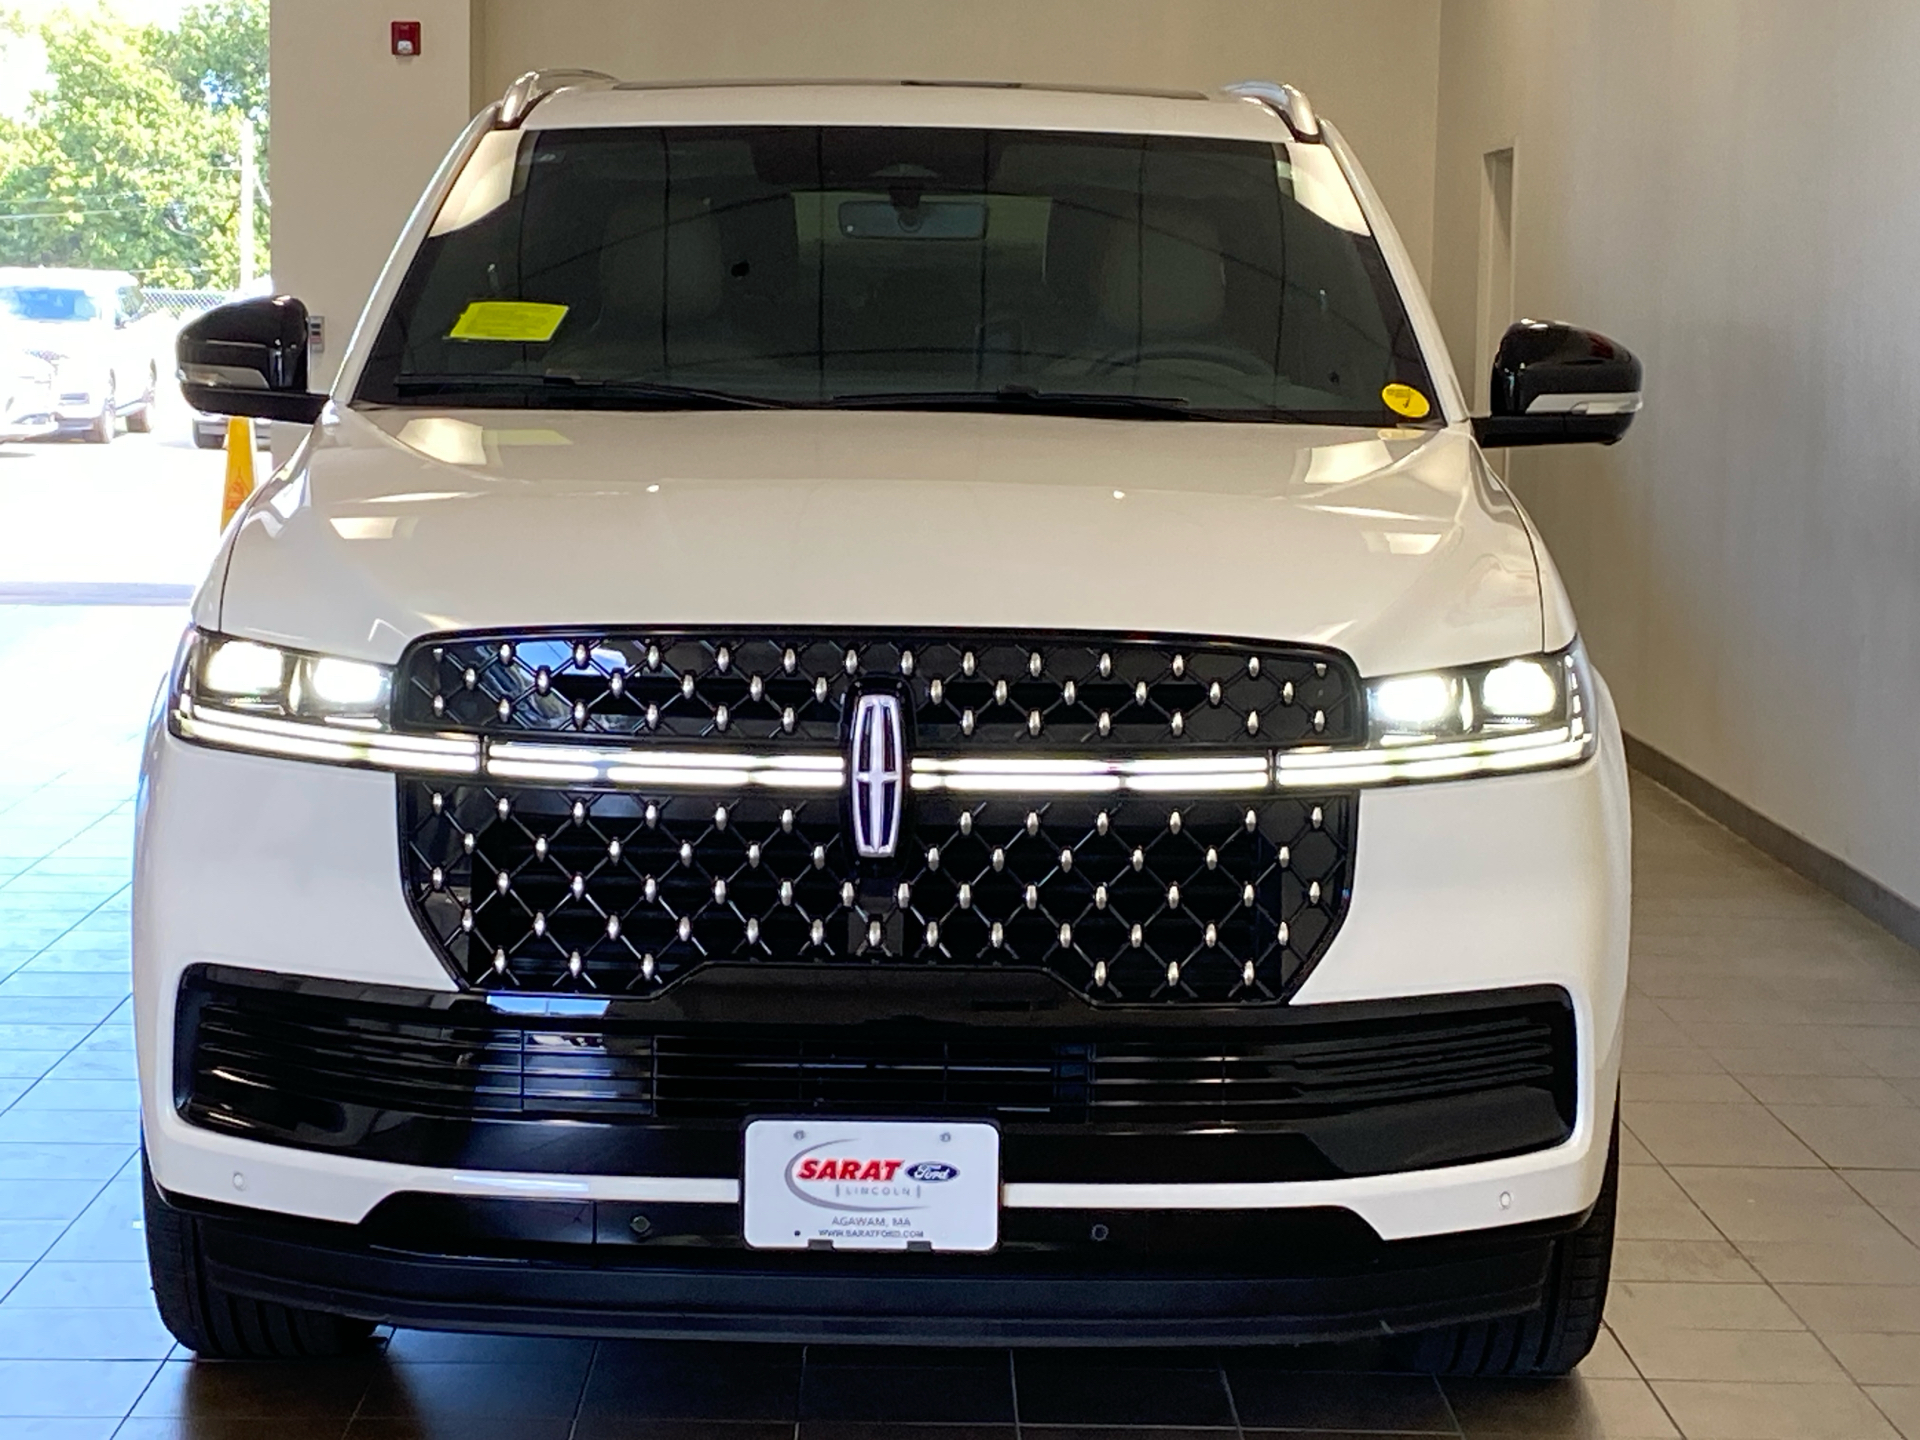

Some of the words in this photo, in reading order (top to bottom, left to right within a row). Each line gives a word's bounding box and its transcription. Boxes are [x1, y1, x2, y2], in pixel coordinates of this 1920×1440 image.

[797, 1159, 904, 1181] SARAT
[913, 1164, 951, 1181] Ford
[845, 1186, 910, 1196] LINCOLN
[832, 1216, 888, 1227] AGAWAM,
[892, 1217, 911, 1227] MA
[818, 1229, 924, 1238] WWW.SARATFORD.COM
